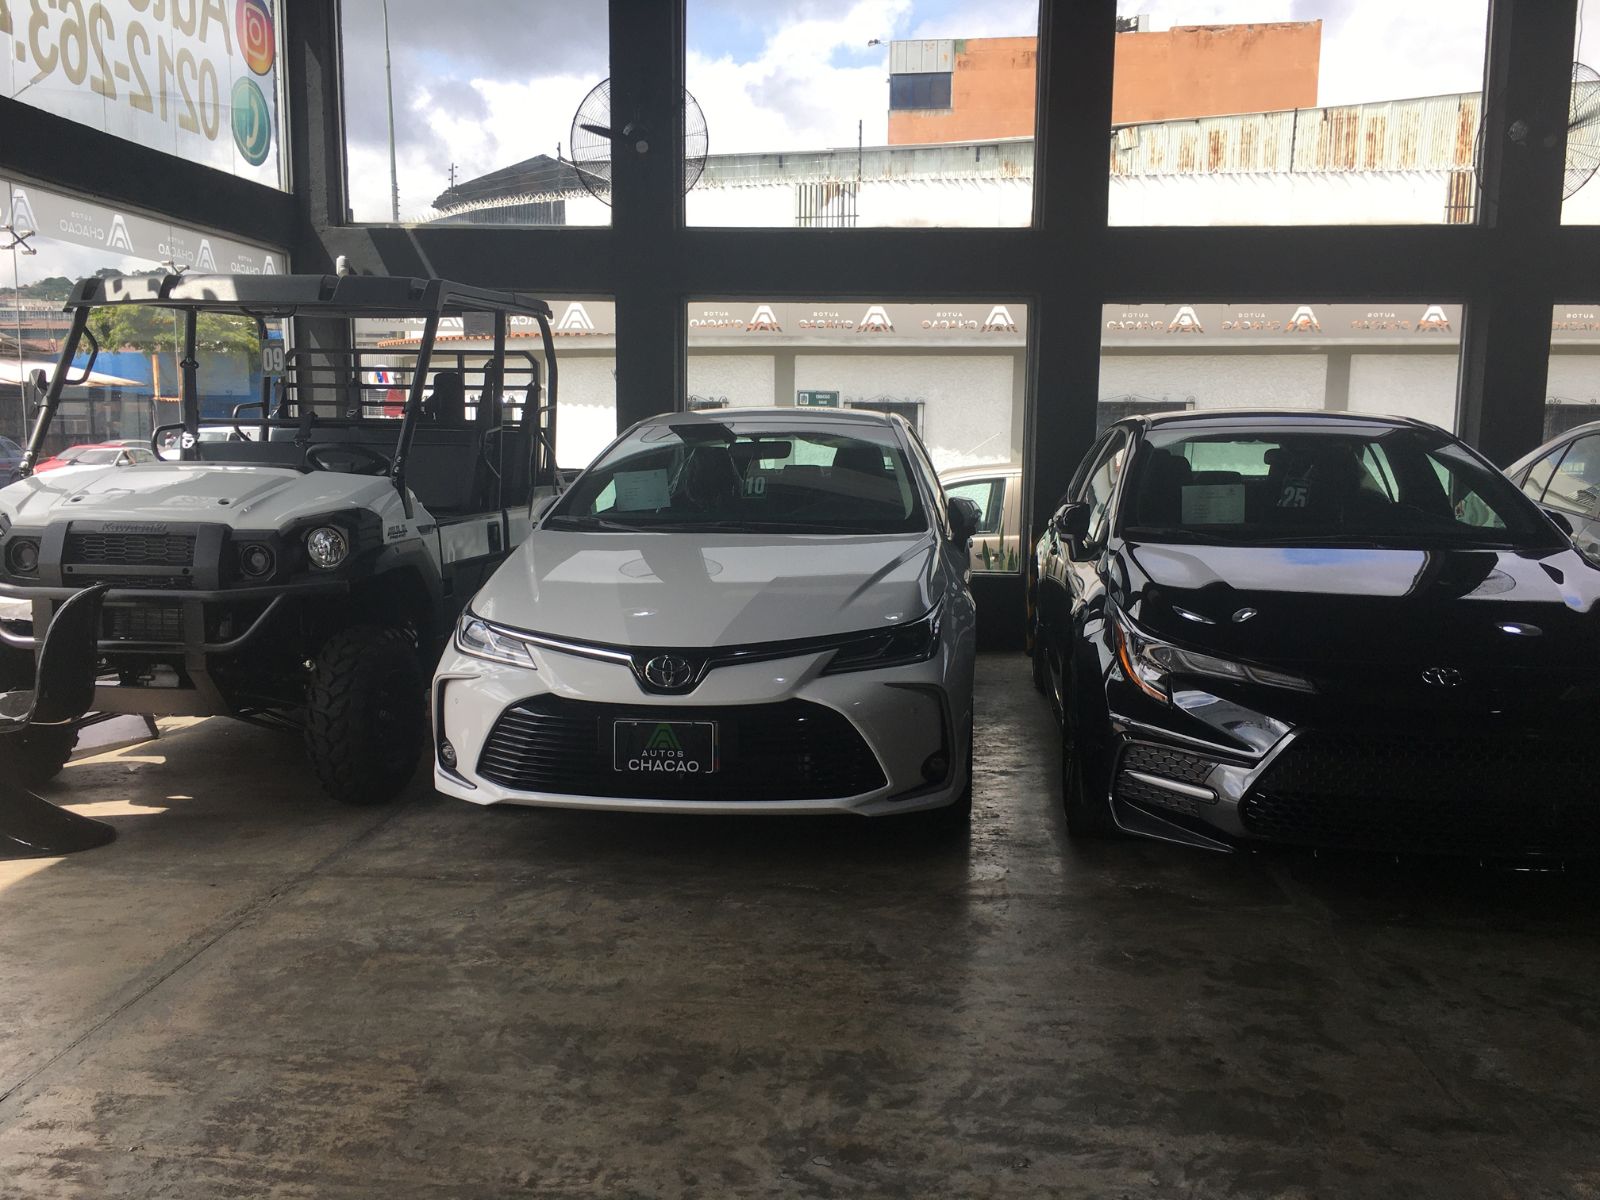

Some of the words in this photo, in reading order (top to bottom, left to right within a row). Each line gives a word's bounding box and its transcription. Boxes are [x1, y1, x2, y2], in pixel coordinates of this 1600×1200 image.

[263, 347, 284, 371] 09
[746, 477, 765, 494] 10
[1282, 486, 1307, 507] 25
[641, 749, 684, 758] AUTOS
[628, 759, 699, 772] CHACAO
